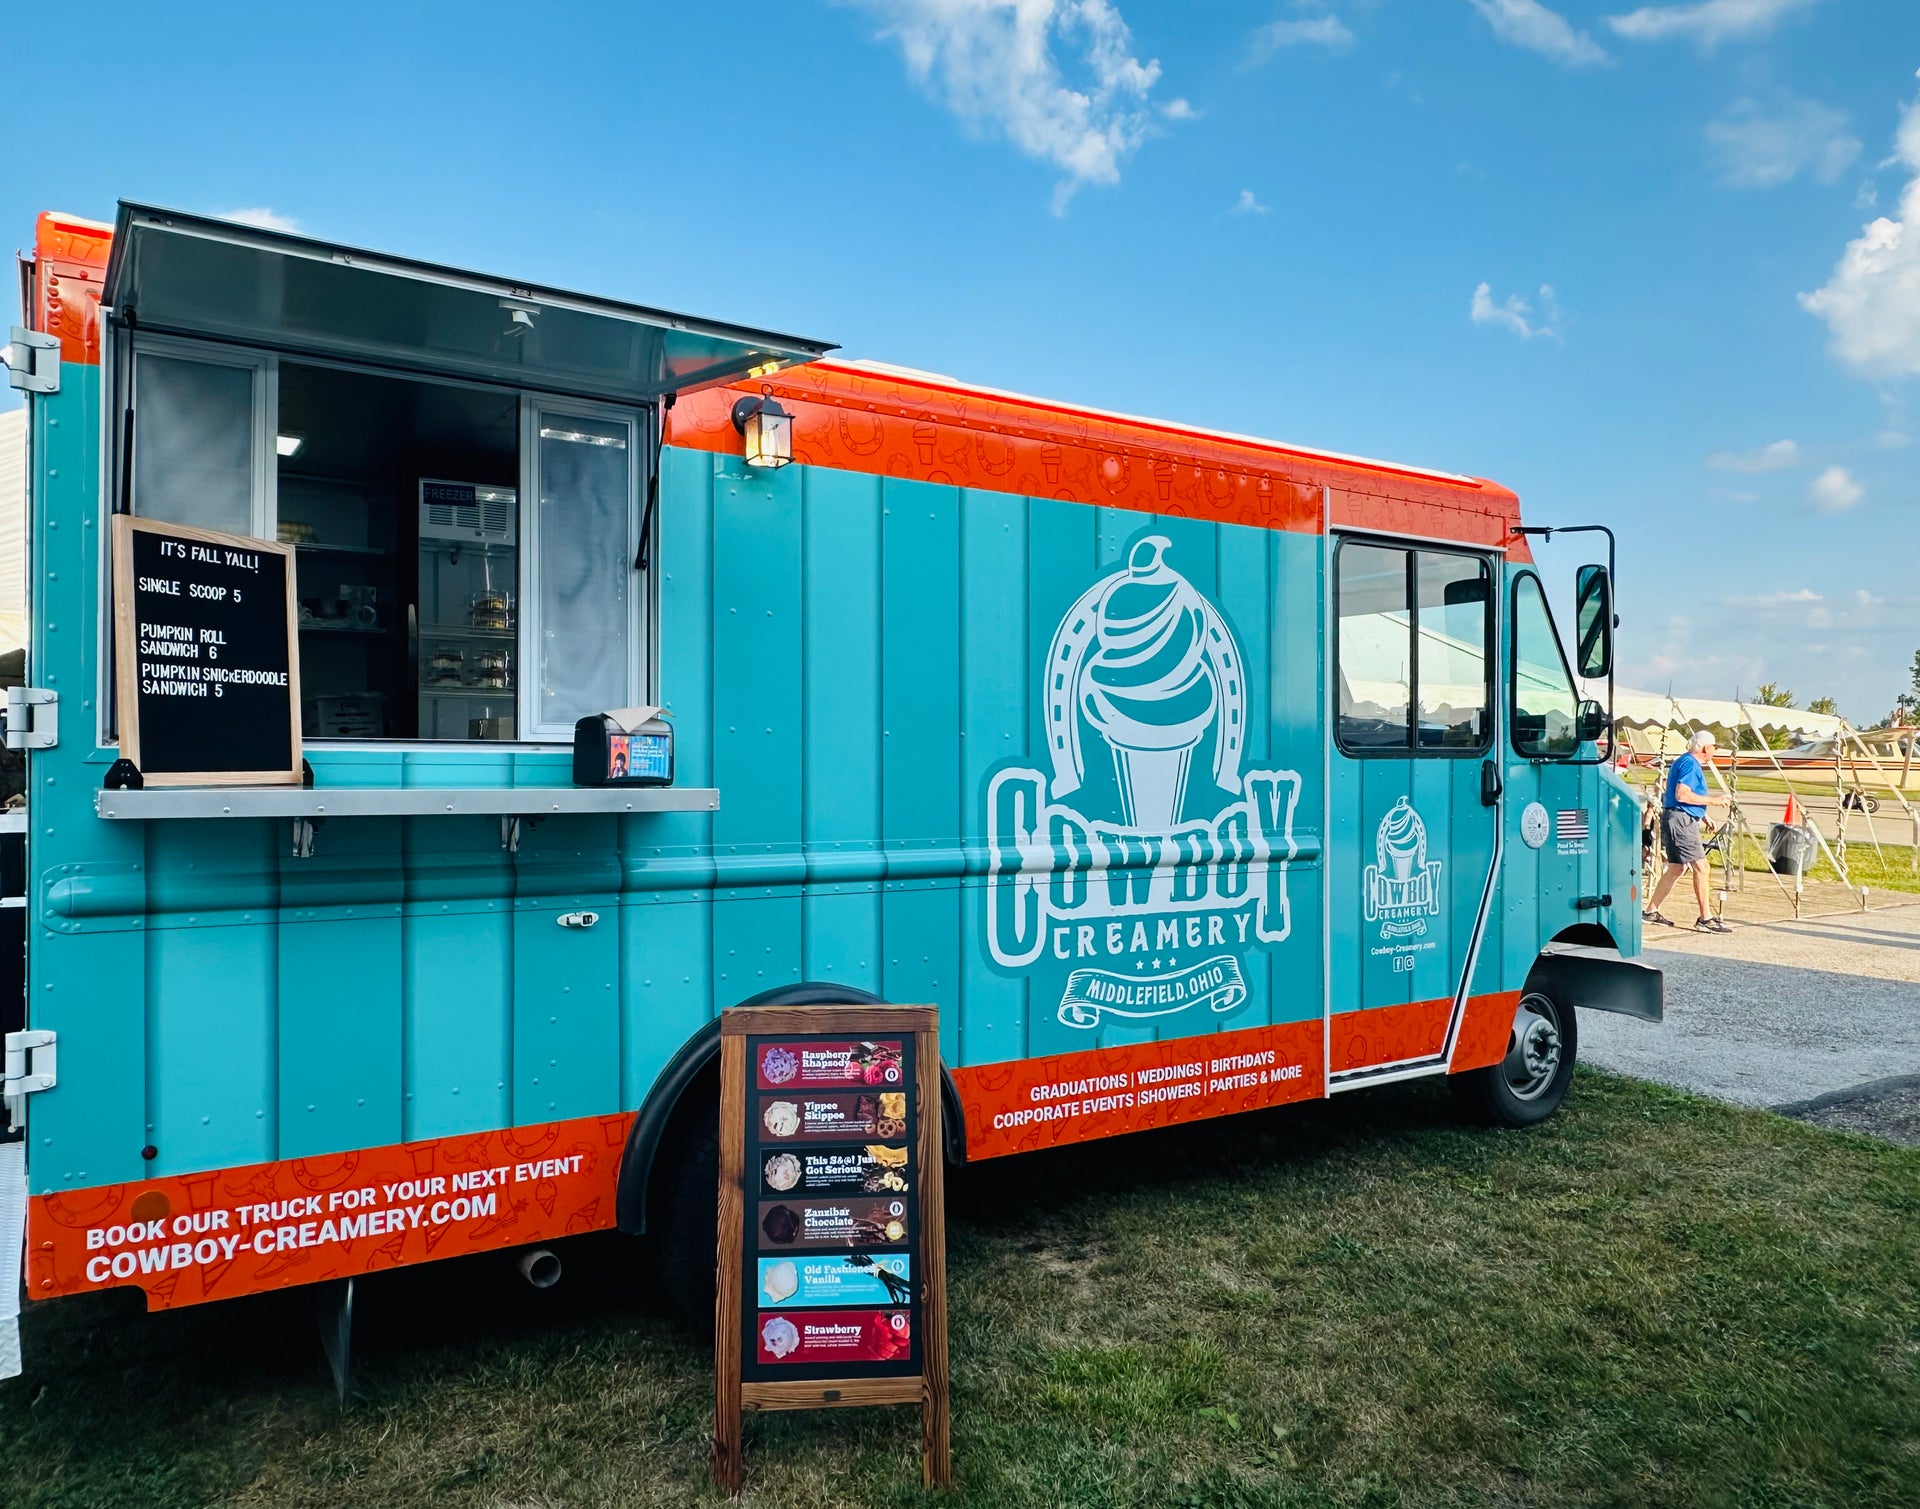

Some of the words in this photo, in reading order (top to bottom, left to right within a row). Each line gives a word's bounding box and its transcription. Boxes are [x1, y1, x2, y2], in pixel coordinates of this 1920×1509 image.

[425, 487, 474, 501] FREEZER
[161, 541, 186, 558] IT'S
[191, 546, 222, 564] FALL
[225, 551, 259, 574] YALL!
[139, 577, 181, 596] SINGLE
[189, 584, 227, 601] SCOOP
[233, 589, 242, 603] 5
[140, 623, 193, 642] PUMPKIN
[200, 629, 227, 645] ROLL
[140, 640, 199, 659] SANDWICH
[209, 646, 218, 660] 6
[142, 663, 200, 681] PUMPKIN
[142, 680, 207, 697] SANDWICH
[214, 684, 223, 698] 5
[987, 767, 1302, 967] COWBOY
[1364, 861, 1442, 921] COWBOY
[1379, 905, 1428, 920] CREAMERY
[1053, 913, 1251, 960] CREAMERY
[1371, 942, 1435, 956] Cowboy-Creamery.com
[1189, 966, 1223, 995] OHIO
[802, 1050, 851, 1061] Raspberry
[802, 1058, 850, 1069] Rhapsody
[1030, 1073, 1128, 1101] GRADUATIONS
[1137, 1062, 1202, 1085] WEDDINGS
[1211, 1050, 1275, 1073] BIRTHDAYS
[993, 1100, 1079, 1130] CORPORATE
[1083, 1093, 1134, 1115] EVENTS
[1210, 1071, 1257, 1093] PARTIES
[1260, 1071, 1268, 1085] &
[1270, 1064, 1303, 1081] MORE
[804, 1101, 838, 1112] Yippee
[804, 1111, 845, 1121] Skippee
[805, 1156, 828, 1165] This
[857, 1155, 877, 1166] Just
[805, 1165, 824, 1175] Got
[825, 1164, 862, 1174] Serious
[86, 1220, 166, 1251] BOOK
[179, 1207, 228, 1237] OUR
[234, 1196, 322, 1226] TRUCK
[328, 1188, 375, 1213] FOR
[382, 1177, 444, 1204] YOUR
[451, 1166, 509, 1192] NEXT
[514, 1155, 584, 1182] EVENT
[804, 1207, 850, 1217] Zanzibar
[804, 1217, 854, 1227] Chocolate
[86, 1193, 497, 1284] COWBOY-CREAMERY.COM
[804, 1265, 821, 1275] Old
[824, 1263, 875, 1274] Fashioned
[804, 1275, 841, 1284] Vanilla
[804, 1323, 862, 1336] Strawberry
